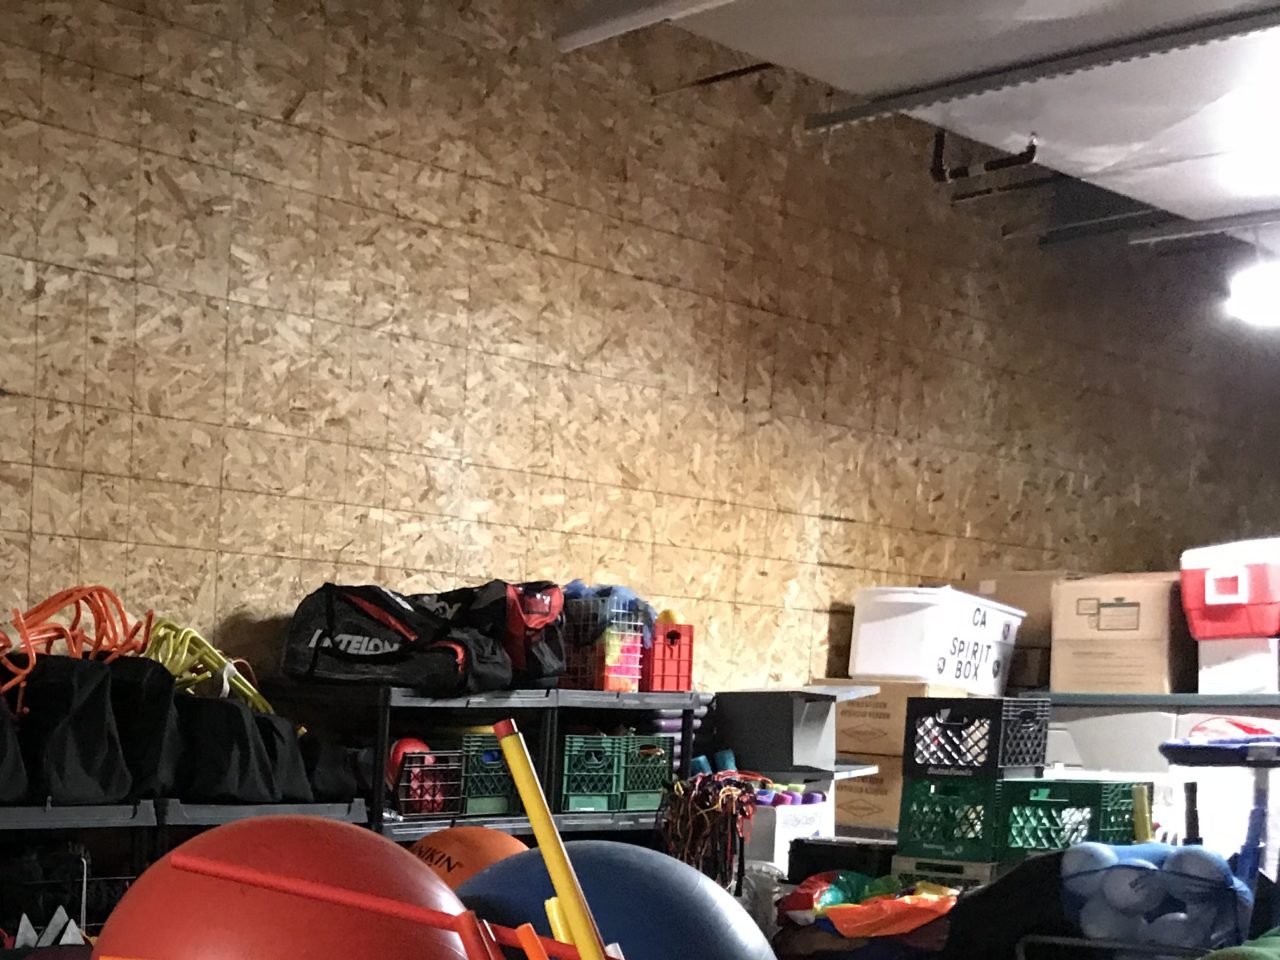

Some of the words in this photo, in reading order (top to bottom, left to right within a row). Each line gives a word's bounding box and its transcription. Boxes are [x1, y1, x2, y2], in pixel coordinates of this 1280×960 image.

[972, 607, 987, 628] CA
[950, 637, 991, 663] SPIRIT
[955, 660, 980, 681] BOX
